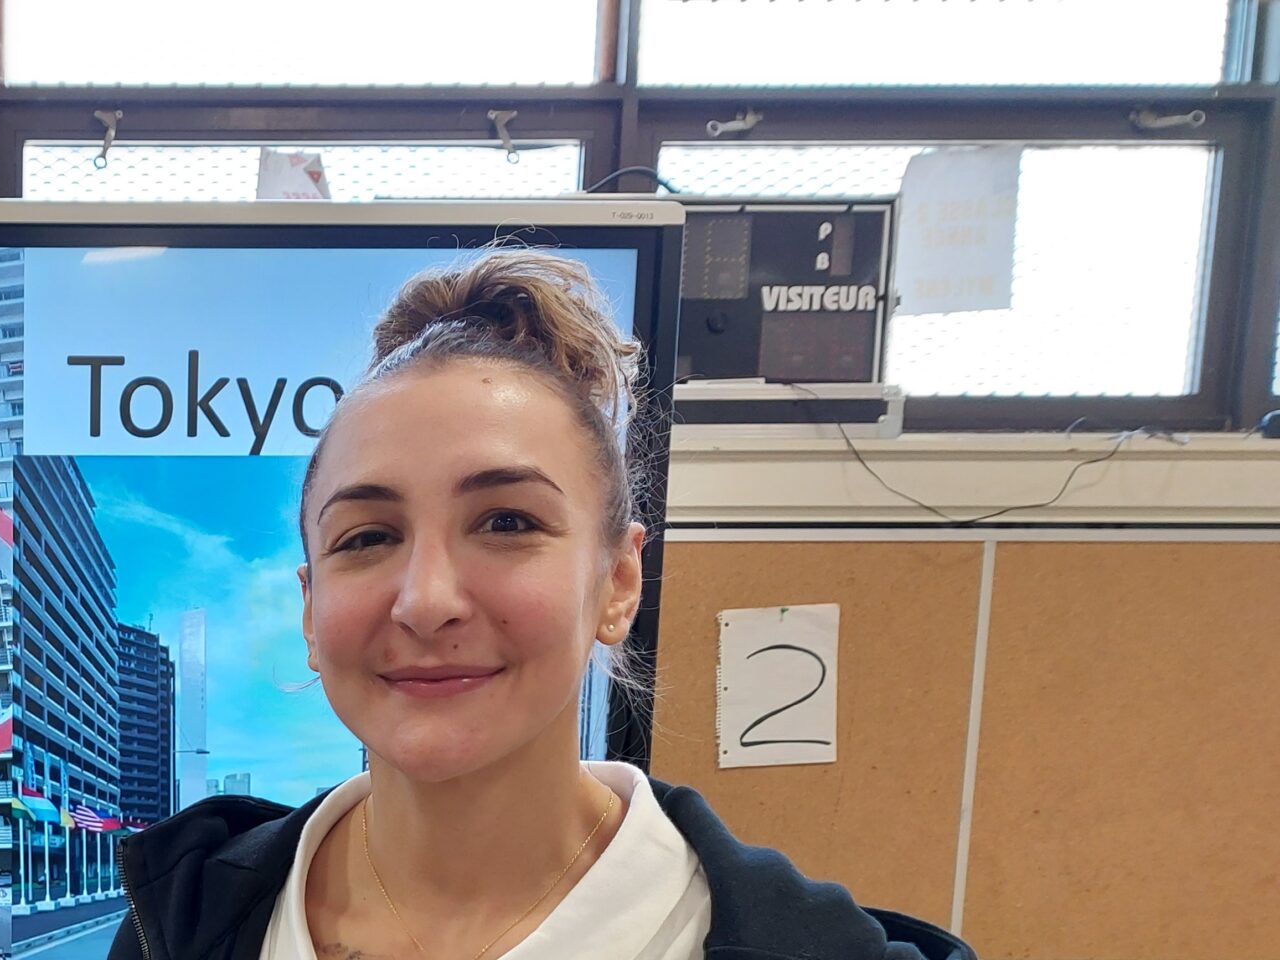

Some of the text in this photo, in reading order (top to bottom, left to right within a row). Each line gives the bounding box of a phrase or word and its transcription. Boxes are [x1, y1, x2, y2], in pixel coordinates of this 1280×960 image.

[818, 221, 833, 241] P
[815, 252, 830, 271] B
[761, 285, 877, 312] VISITEUR
[67, 350, 345, 456] Tokyo
[740, 644, 831, 747] 2
